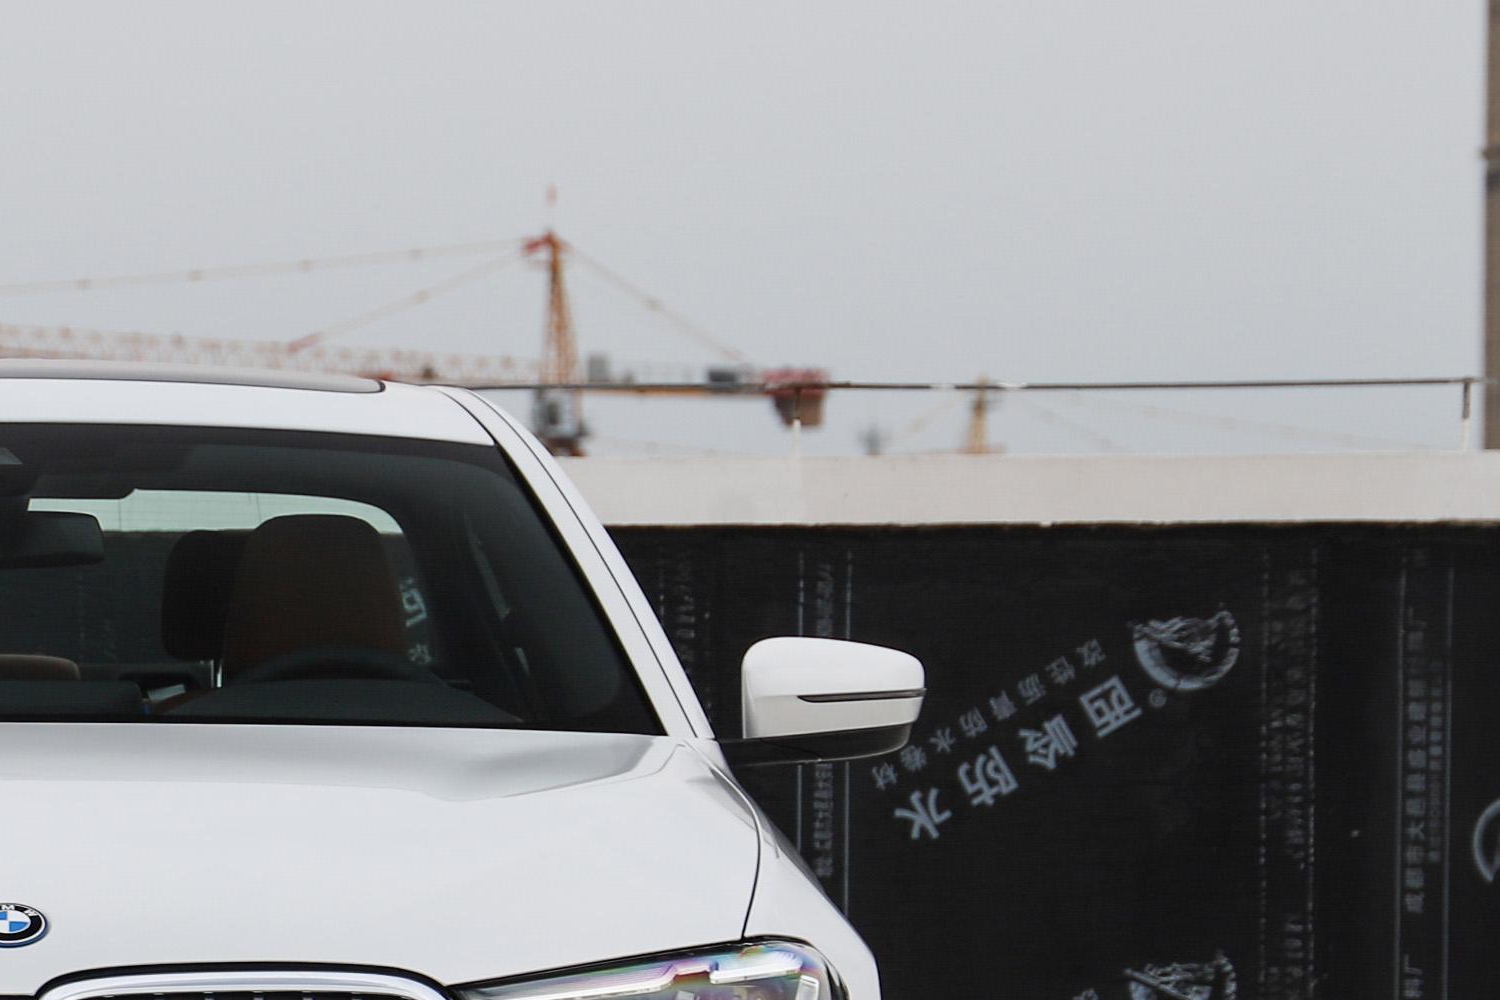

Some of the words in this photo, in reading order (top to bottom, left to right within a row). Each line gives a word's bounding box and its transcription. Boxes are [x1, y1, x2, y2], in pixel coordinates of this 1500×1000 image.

[871, 638, 1106, 791] 改性沥青防水卷材
[894, 675, 1143, 841] 西岭防水
